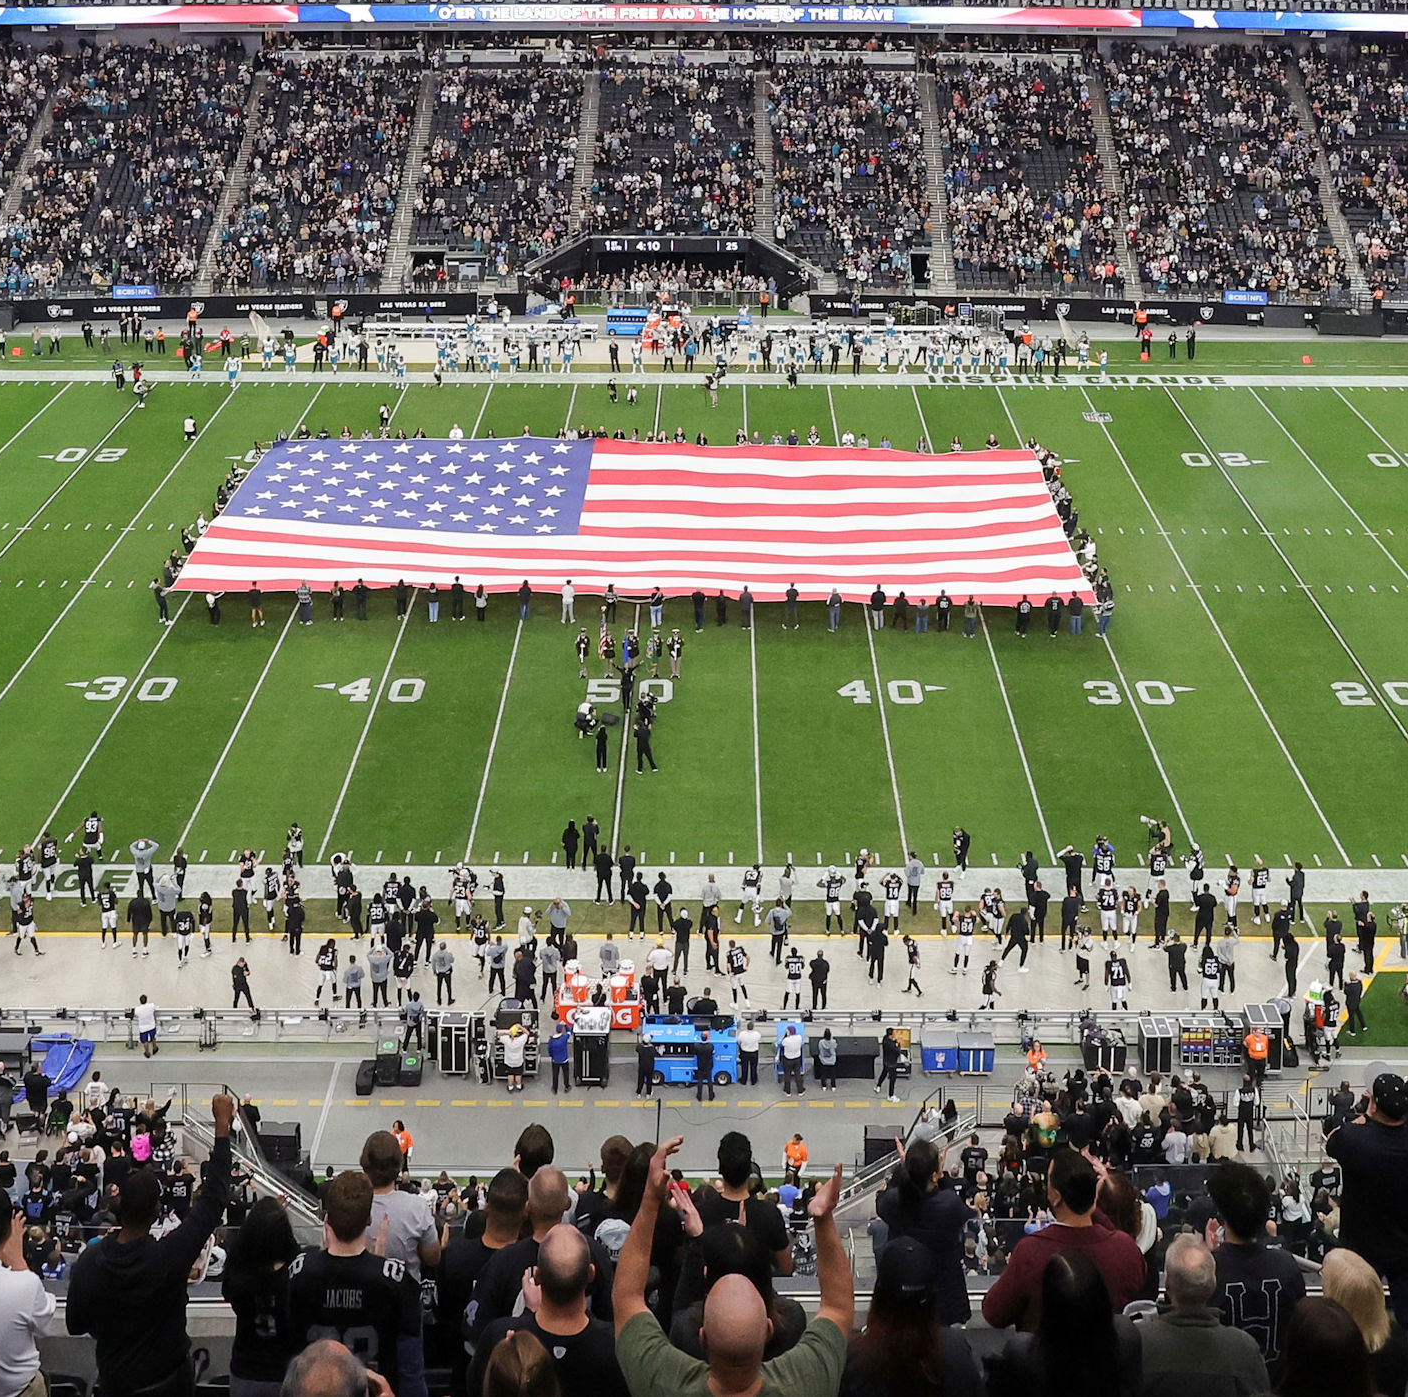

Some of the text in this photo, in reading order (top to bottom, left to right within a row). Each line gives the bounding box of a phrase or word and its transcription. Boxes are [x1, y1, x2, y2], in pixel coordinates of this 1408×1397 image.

[479, 6, 511, 20] THE
[513, 6, 557, 20] LAND
[559, 6, 582, 20] OF
[585, 6, 616, 20] THE
[619, 6, 659, 20] FREE
[661, 6, 695, 20] AND
[698, 7, 730, 21] THE
[733, 7, 780, 21] HOME
[783, 7, 806, 21] OF
[808, 7, 839, 21] THE
[843, 7, 894, 21] BRAVE
[635, 240, 739, 251] 4:10 25
[122, 288, 152, 296] CBS NFL
[1233, 294, 1264, 303] CBS NFL
[93, 305, 161, 314] LAS VEGAS RAIDERS
[236, 303, 249, 312] LAS
[250, 303, 273, 312] VEGAS
[379, 301, 447, 309] LAS VEGAS RADERS
[1101, 307, 1115, 316] LAS
[928, 374, 1226, 386] INSPIRE CHANGE
[82, 676, 179, 702] 30
[337, 678, 427, 704] 40
[586, 678, 675, 704] 50
[836, 679, 926, 705] 40
[1082, 680, 1177, 706] 30
[1097, 860, 1111, 872] 58
[103, 898, 111, 910] 5
[1102, 894, 1116, 907] 74
[370, 907, 383, 920] 29
[961, 921, 974, 934] 84
[732, 955, 745, 968] 12
[788, 962, 802, 975] 80
[1111, 967, 1126, 980] 71
[1204, 963, 1218, 975] 66
[615, 1010, 633, 1024] G
[323, 1287, 364, 1310] JACOBS
